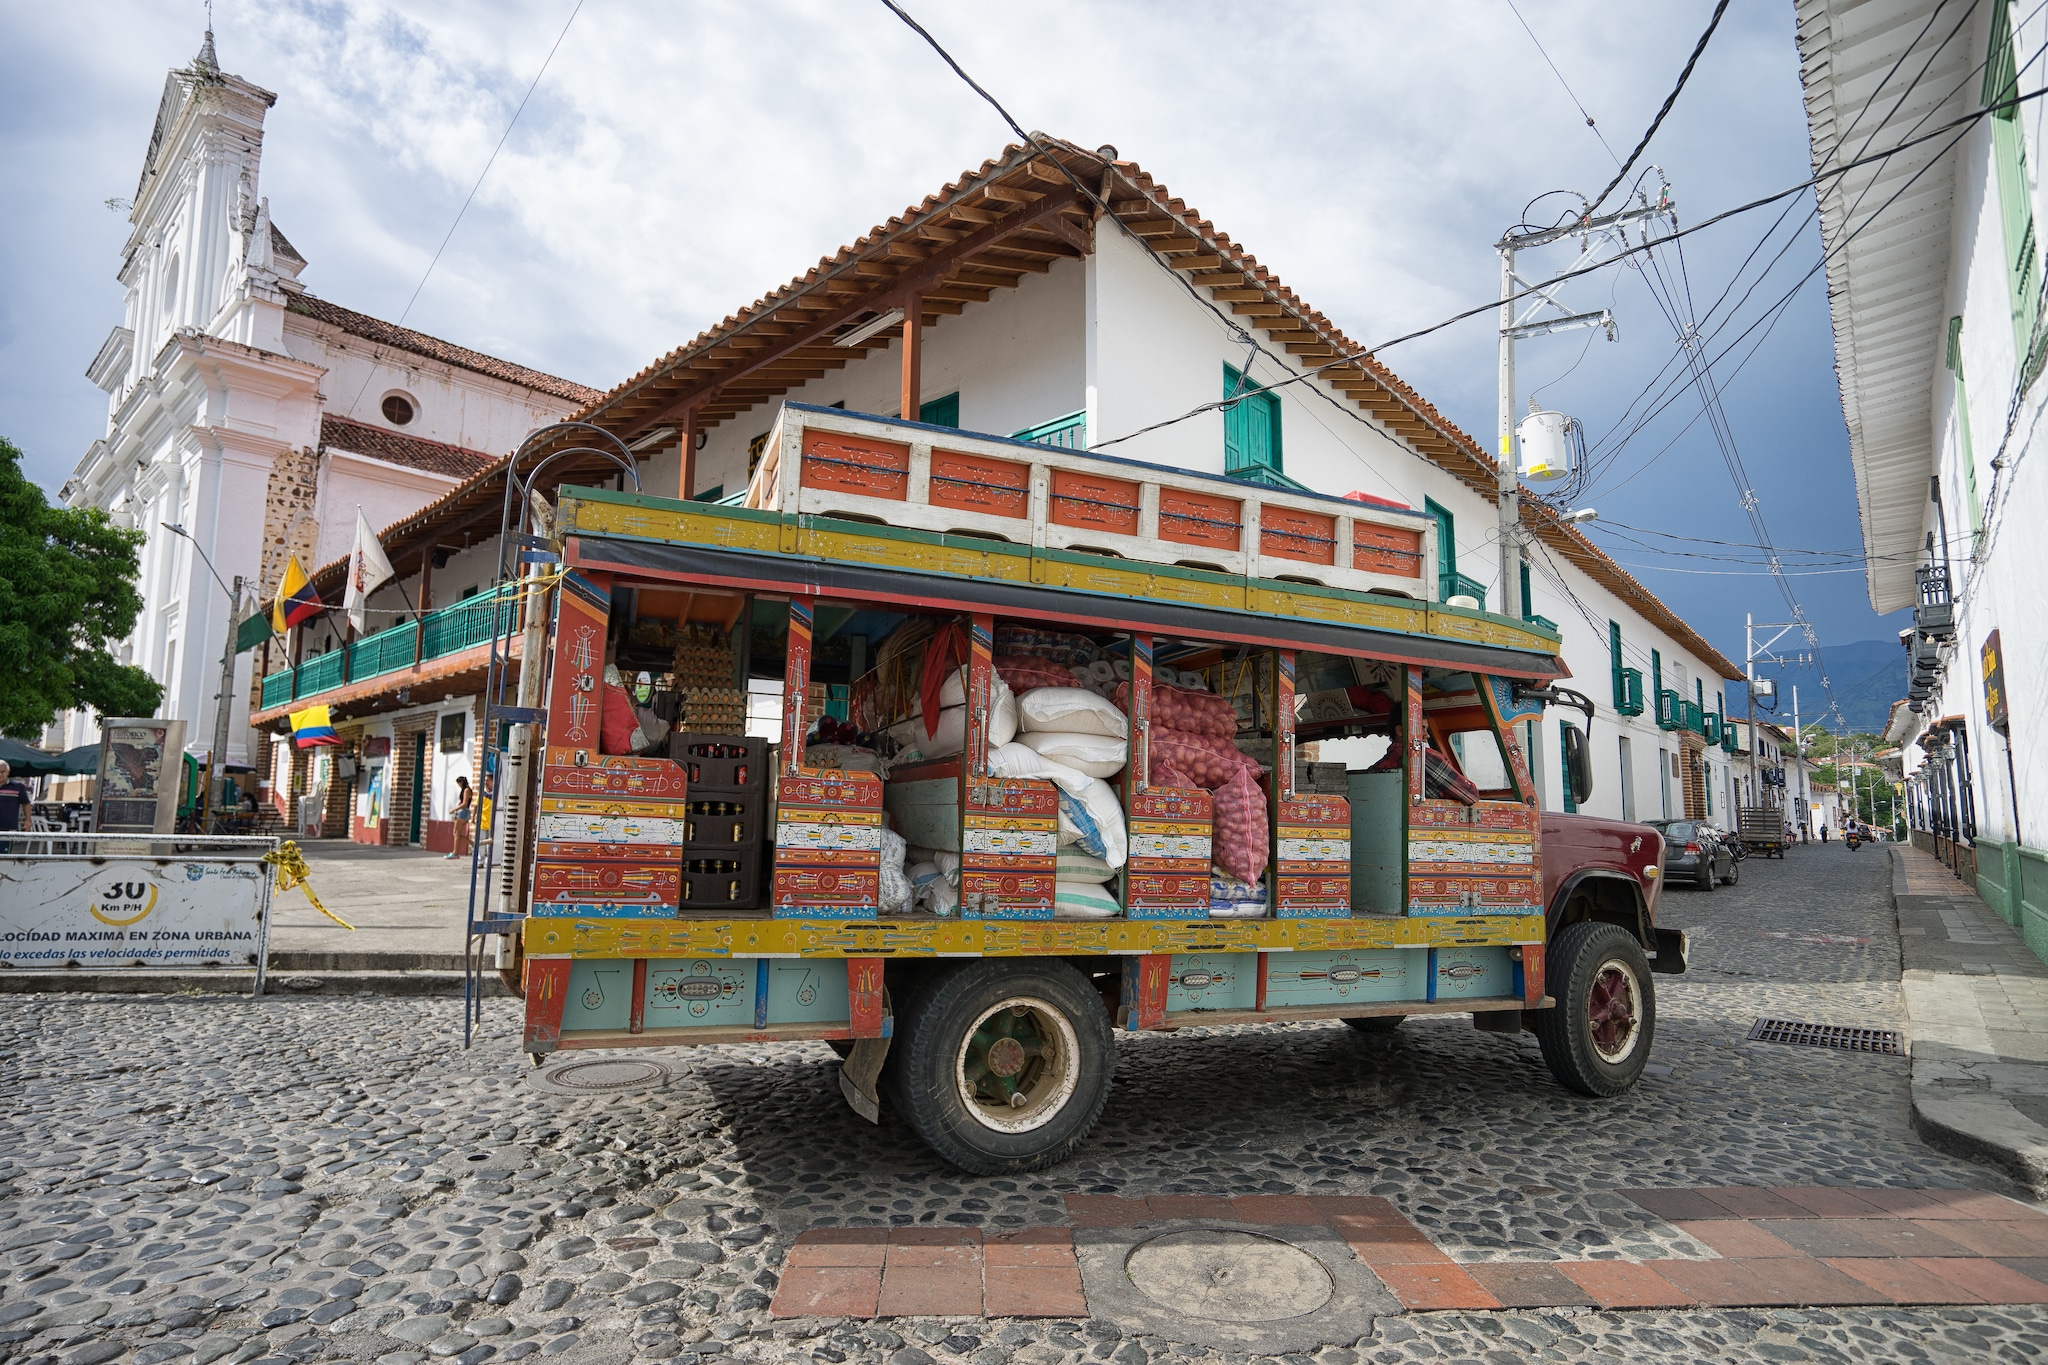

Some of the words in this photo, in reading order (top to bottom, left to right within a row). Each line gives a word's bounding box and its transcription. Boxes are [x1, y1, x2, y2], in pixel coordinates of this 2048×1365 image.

[65, 932, 125, 941] MAXIMA
[129, 931, 148, 940] EN
[152, 931, 190, 940] ZONA
[195, 931, 252, 940] URBANA
[14, 949, 66, 959] excedas
[68, 948, 87, 958] las
[90, 948, 162, 958] velocidades
[165, 947, 231, 960] permitidas
